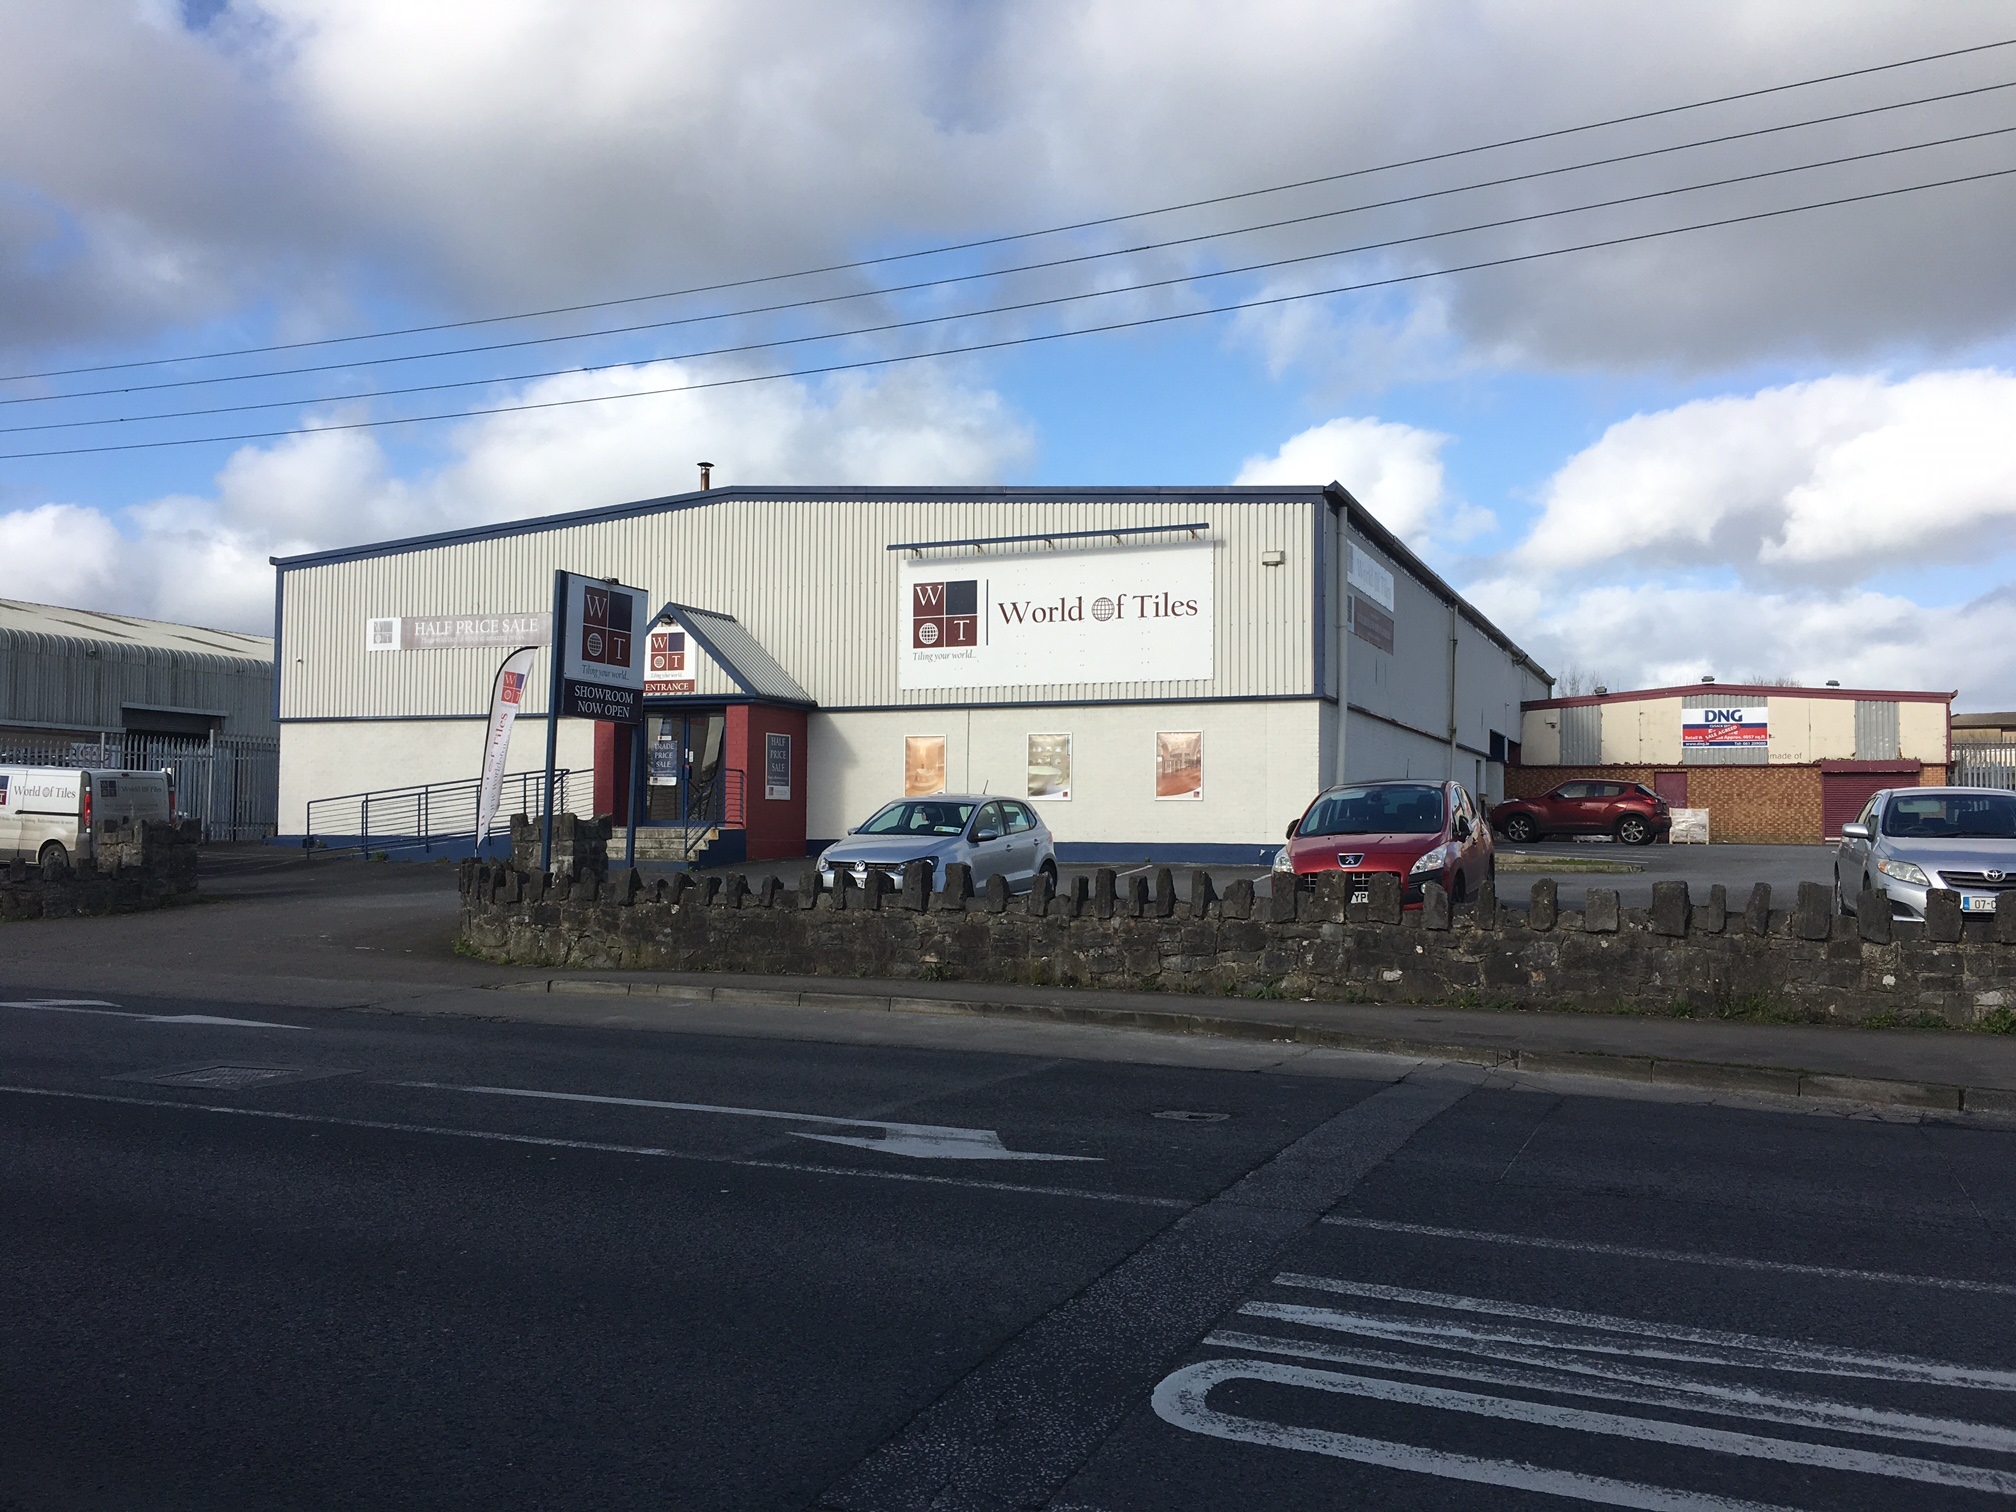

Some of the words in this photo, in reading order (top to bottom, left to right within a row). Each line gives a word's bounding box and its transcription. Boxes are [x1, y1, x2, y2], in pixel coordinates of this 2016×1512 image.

[997, 597, 1084, 625] World
[1131, 592, 1199, 619] Tiles
[415, 621, 452, 635] HALF
[456, 619, 499, 634] PRICE
[502, 618, 538, 632] SALE
[913, 651, 933, 663] Tiling
[934, 653, 951, 662] your
[582, 664, 598, 679] Tiling
[598, 669, 611, 680] your
[645, 683, 689, 691] ENTRANCE
[574, 685, 634, 704] SHOWROOM
[577, 700, 603, 714] NOW
[605, 704, 630, 718] OPEN
[1704, 709, 1743, 723] DNG
[1705, 732, 1718, 740] SALE
[1717, 725, 1738, 736] AGREED
[771, 736, 786, 746] HALF
[770, 750, 786, 760] PRICE
[656, 760, 671, 768] SALE
[771, 762, 786, 773] SALE
[14, 785, 41, 797] World
[55, 787, 76, 799] Tiles
